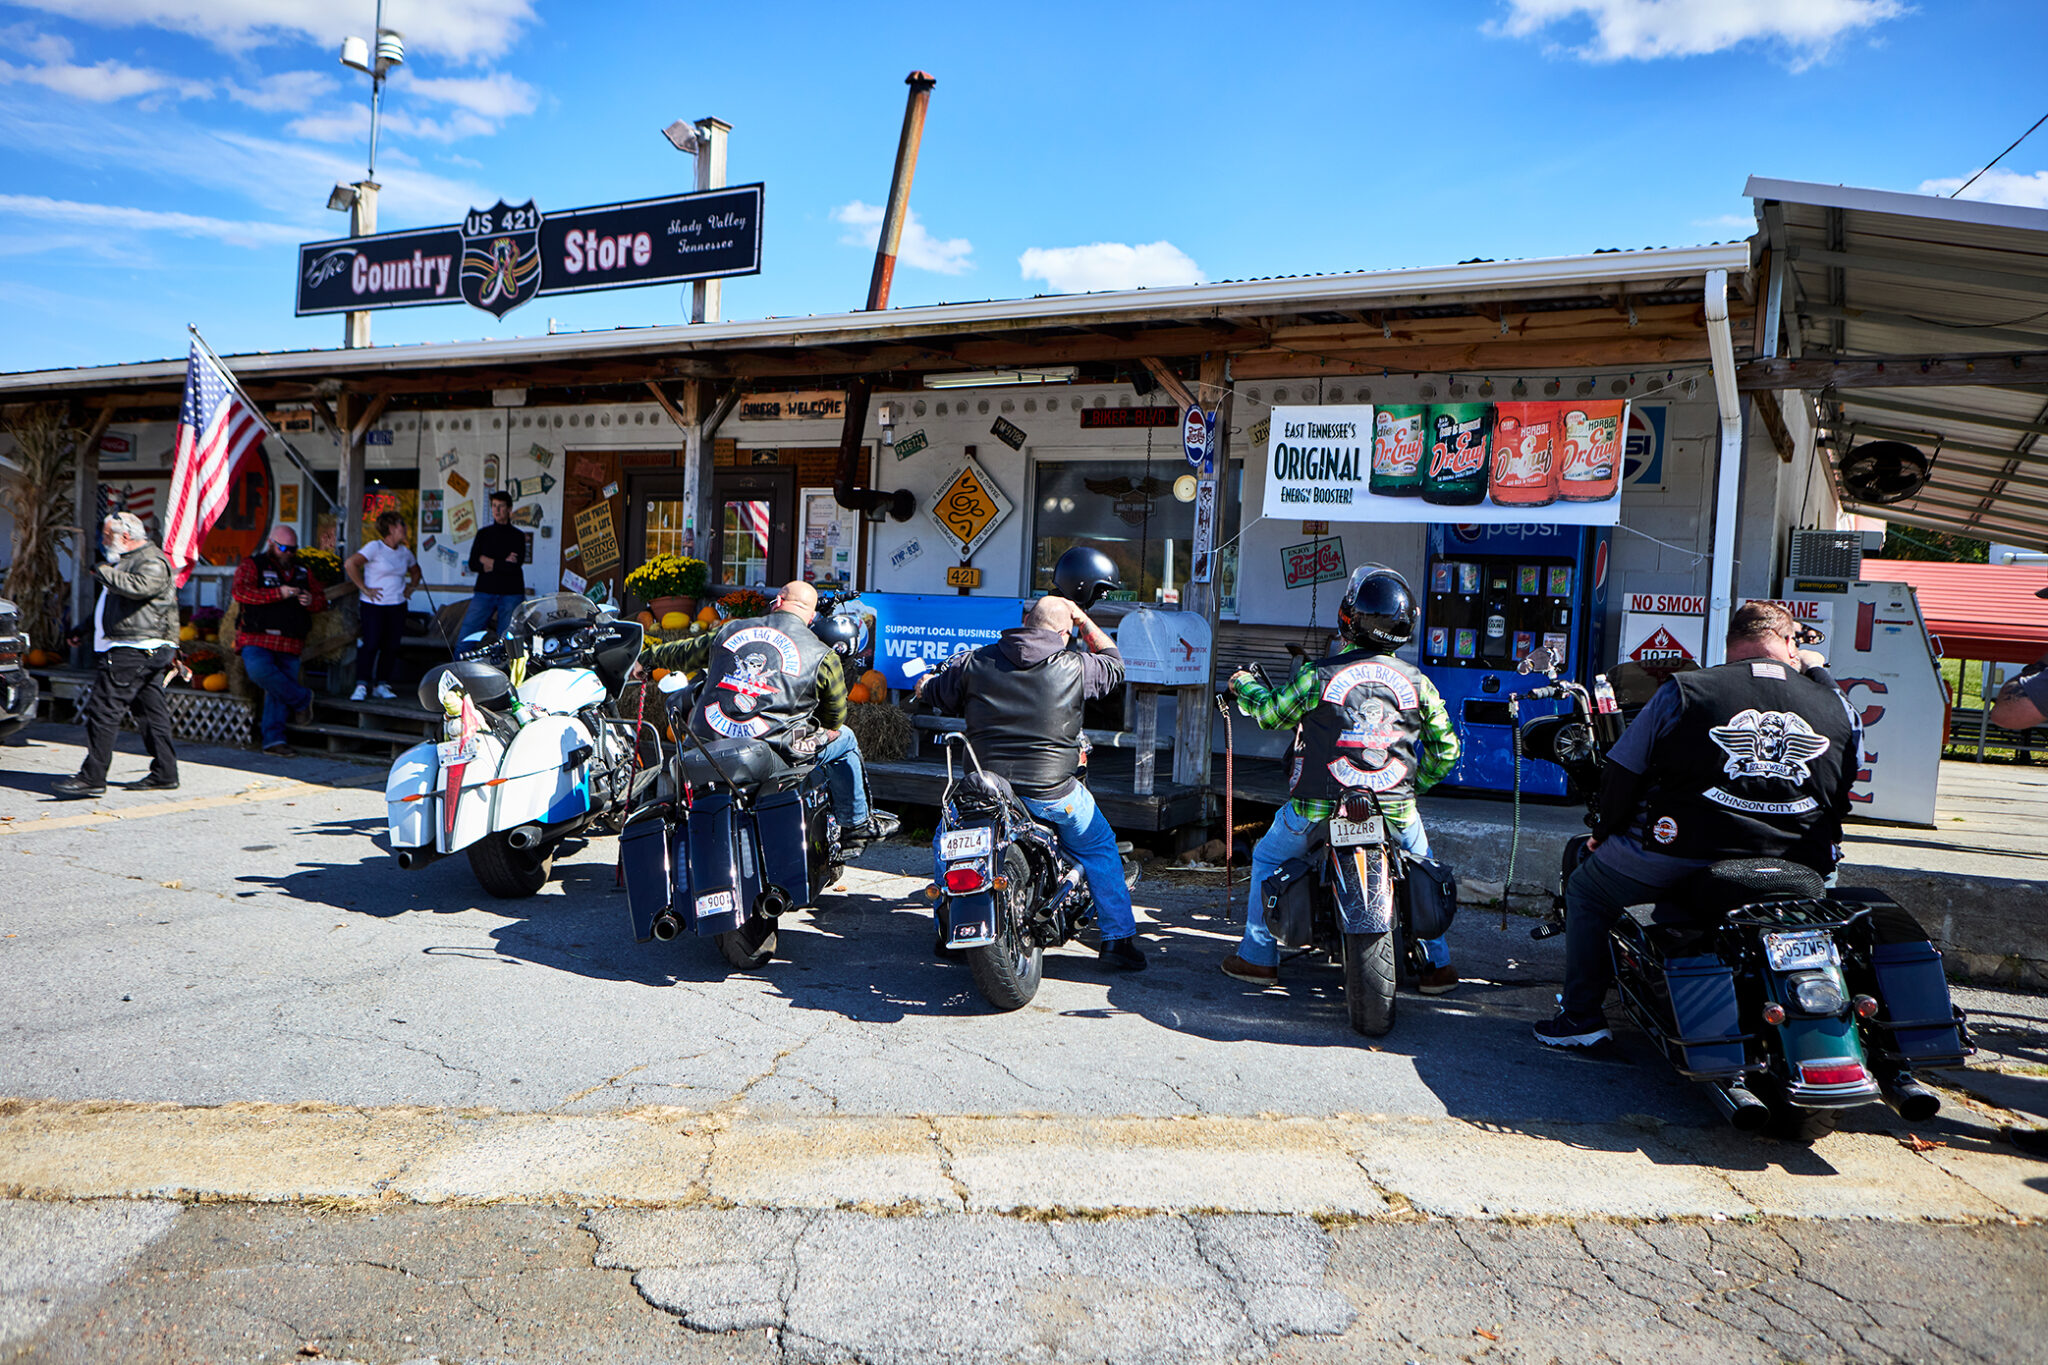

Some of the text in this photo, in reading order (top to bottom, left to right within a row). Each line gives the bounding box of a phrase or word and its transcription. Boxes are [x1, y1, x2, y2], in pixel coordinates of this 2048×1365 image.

[467, 209, 537, 236] US 421
[667, 212, 746, 236] Shady Valley
[678, 239, 733, 254] Tennessee
[304, 228, 652, 296] The Country Store
[788, 400, 842, 415] WELCOME
[1092, 409, 1166, 425] BIKER BLVD
[1285, 422, 1305, 438] EAST
[1308, 422, 1356, 439] TENNESSEE'S
[1391, 428, 1424, 465] Enuf
[1452, 432, 1487, 473] Enuf
[1274, 443, 1362, 480] ORIGINAL
[983, 479, 1000, 499] CURVES
[1281, 486, 1353, 504] ENERGY BOOSTER!
[576, 503, 609, 526] LOOK TWICE
[579, 525, 592, 539] SAVE
[599, 517, 611, 531] LIFE
[973, 518, 1000, 547] ONE VALLEY
[583, 537, 617, 563] DYING
[1288, 546, 1310, 556] ENJOY
[951, 570, 974, 584] 421
[1632, 594, 1706, 613] NO SMOKI
[885, 625, 1002, 639] SUPPORT LOCAL BUSINESS
[727, 629, 798, 673] DOG TAG BRIGADE
[885, 638, 948, 660] WE'RE
[1327, 664, 1417, 709] DOG TAG BRIGADE
[709, 710, 757, 738] MILITARY
[1339, 765, 1398, 790] MILITARY
[1710, 790, 1765, 811] JOHNSON
[1337, 821, 1375, 836] 112ZR8
[946, 835, 982, 851] 487ZL4
[1776, 940, 1825, 958] 505ZW5
